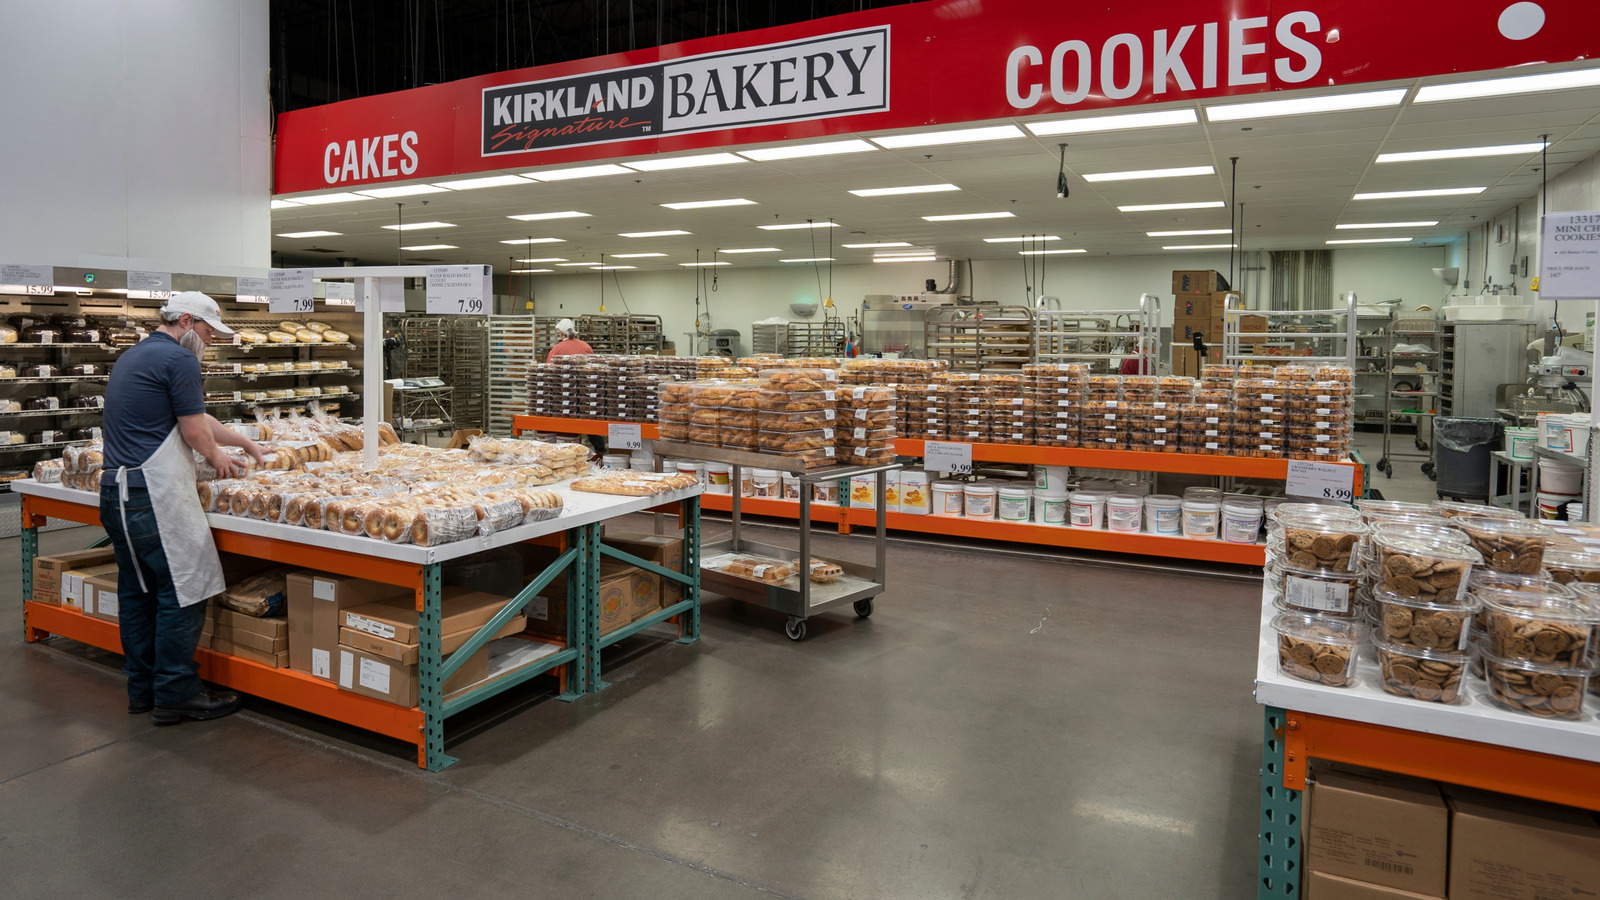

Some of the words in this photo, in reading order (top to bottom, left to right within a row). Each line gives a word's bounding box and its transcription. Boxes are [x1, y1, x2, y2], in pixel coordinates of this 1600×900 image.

[1006, 10, 1322, 109] COOKIES
[493, 76, 654, 126] KIRKLAND
[668, 44, 876, 120] BAKERY
[491, 116, 652, 150] Signature
[323, 130, 418, 184] CAKES
[294, 300, 313, 311] 7.99
[458, 300, 482, 312] 7.99
[951, 463, 971, 472] 9.99
[1323, 488, 1351, 499] 8.99
